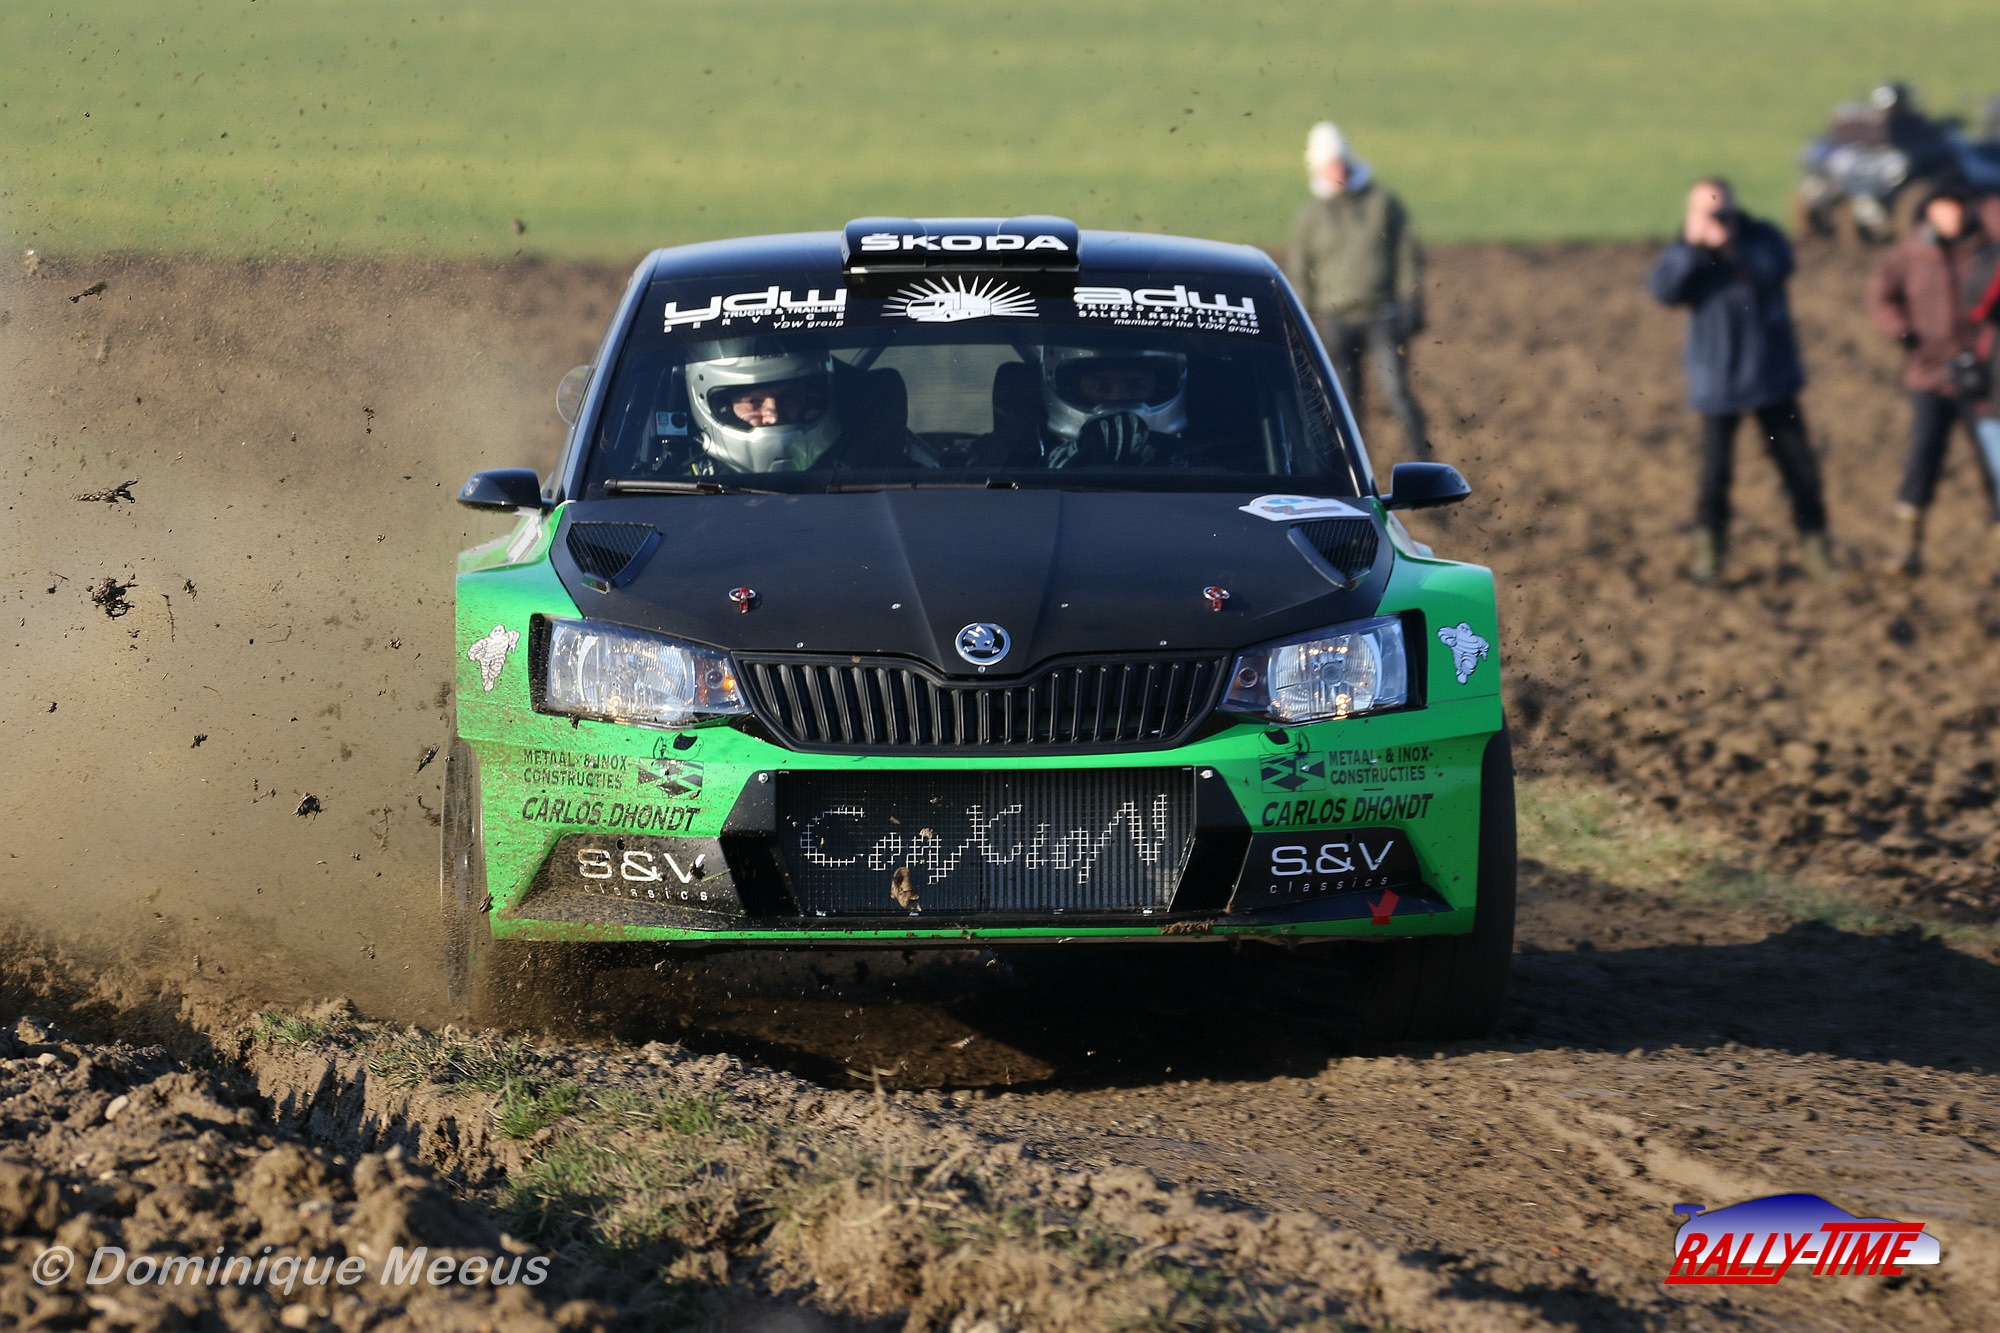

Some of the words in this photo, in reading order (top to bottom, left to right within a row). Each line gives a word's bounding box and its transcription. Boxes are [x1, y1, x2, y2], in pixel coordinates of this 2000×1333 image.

[860, 233, 1069, 251] ŠKODA
[1073, 284, 1256, 314] adw
[722, 309, 772, 318] TRUCKS
[787, 306, 846, 314] TRAILERS
[1076, 303, 1145, 312] TRUCKS
[1154, 305, 1163, 313] &
[1172, 307, 1258, 321] TRAILERS
[1078, 311, 1130, 319] SALES
[1148, 312, 1188, 321] RENT
[1208, 315, 1259, 328] LEASE
[773, 320, 803, 329] YDW
[807, 320, 845, 329] group
[1114, 318, 1160, 327] member
[1162, 319, 1174, 327] of
[1176, 319, 1194, 328] the
[1197, 321, 1226, 331] YDW
[1228, 324, 1260, 335] group
[1385, 748, 1394, 763] &
[523, 767, 623, 789] CONSTRUCTIES
[1330, 766, 1425, 785] CONSTRUCTIES
[522, 797, 604, 825] CARLOS
[608, 802, 701, 831] DHONDT
[1262, 797, 1346, 826] CARLOS
[1352, 793, 1434, 822] DHONDT
[1271, 841, 1394, 876] S&V
[584, 883, 708, 901] classics
[1270, 877, 1388, 894] classics
